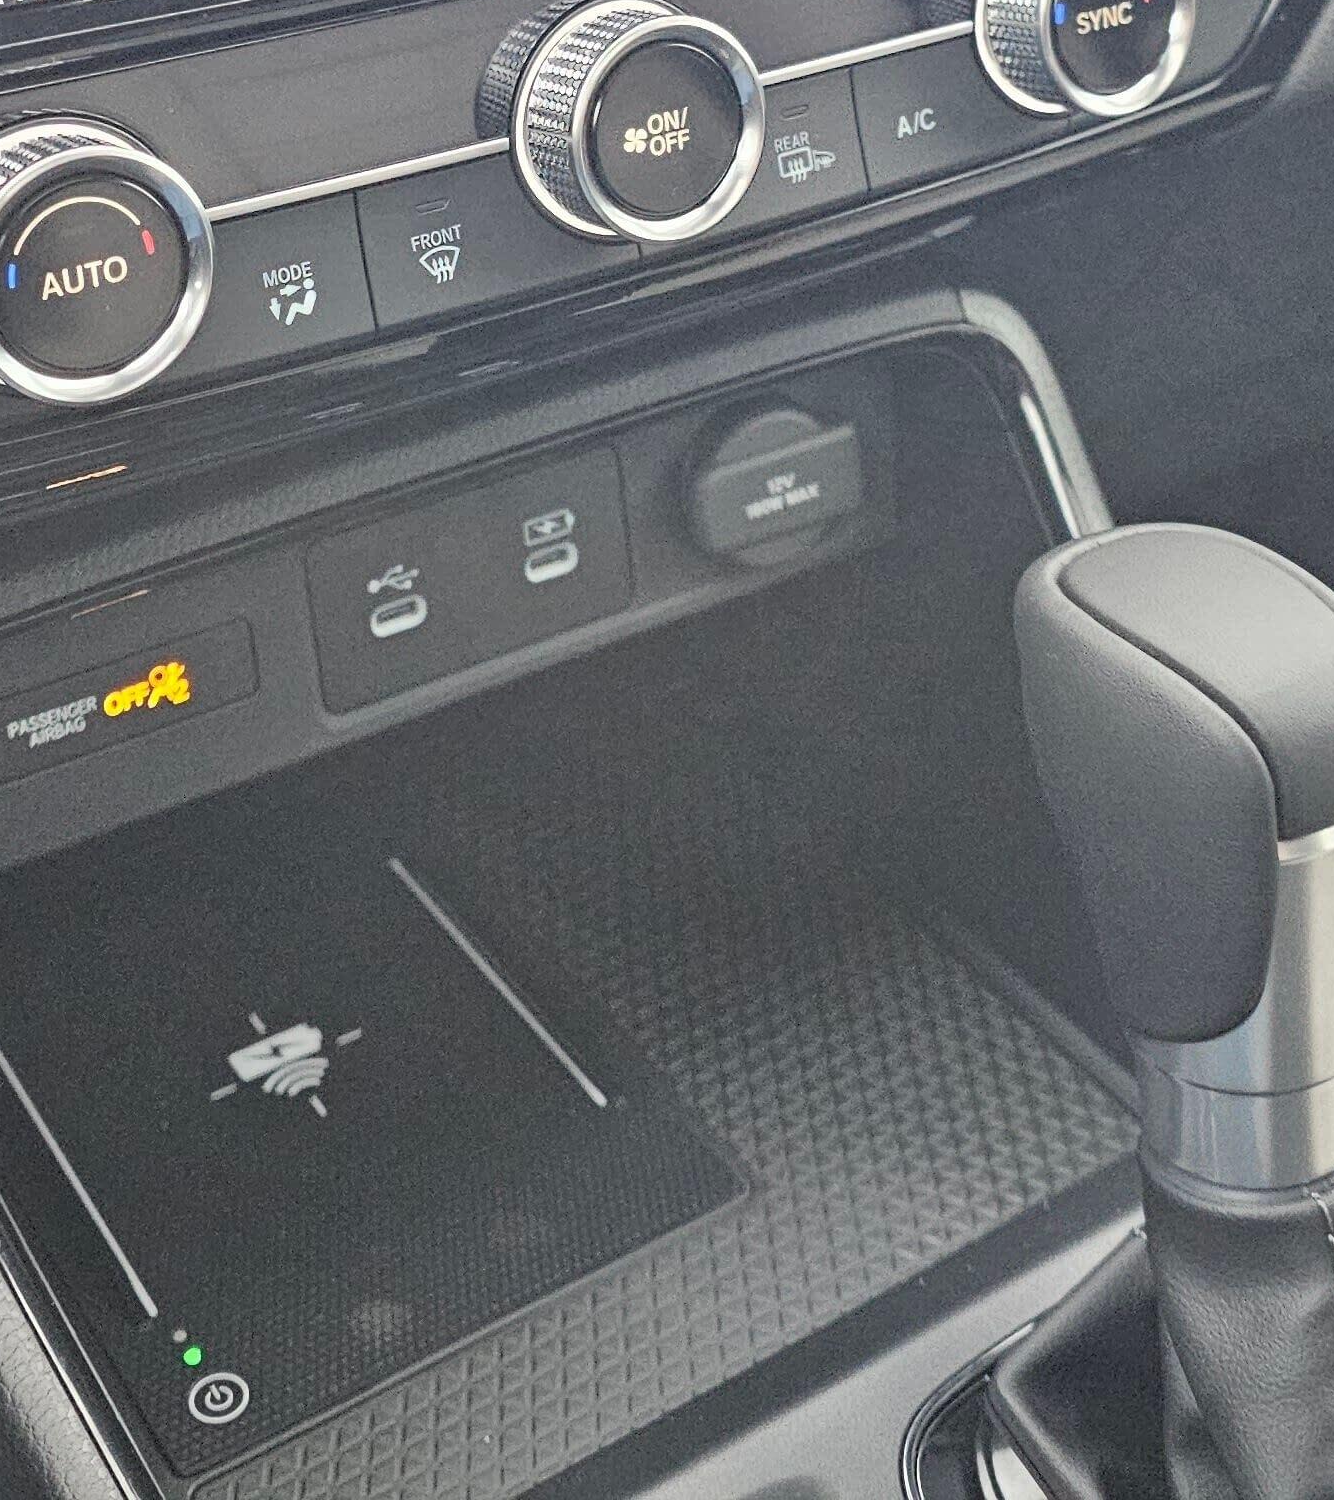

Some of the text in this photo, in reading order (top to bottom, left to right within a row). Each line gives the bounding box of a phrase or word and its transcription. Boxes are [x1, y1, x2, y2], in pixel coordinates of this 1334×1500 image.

[1076, 1, 1134, 36] SYNC
[647, 106, 689, 133] ON/
[895, 107, 937, 139] A/C
[649, 128, 691, 157] OFF
[773, 131, 811, 154] REAR
[410, 223, 463, 253] FRONT
[41, 254, 129, 301] AUTO
[262, 260, 313, 289] MODE
[103, 681, 150, 717] OFF
[7, 695, 97, 740] PASSENGER
[28, 715, 86, 749] AIRBAG
